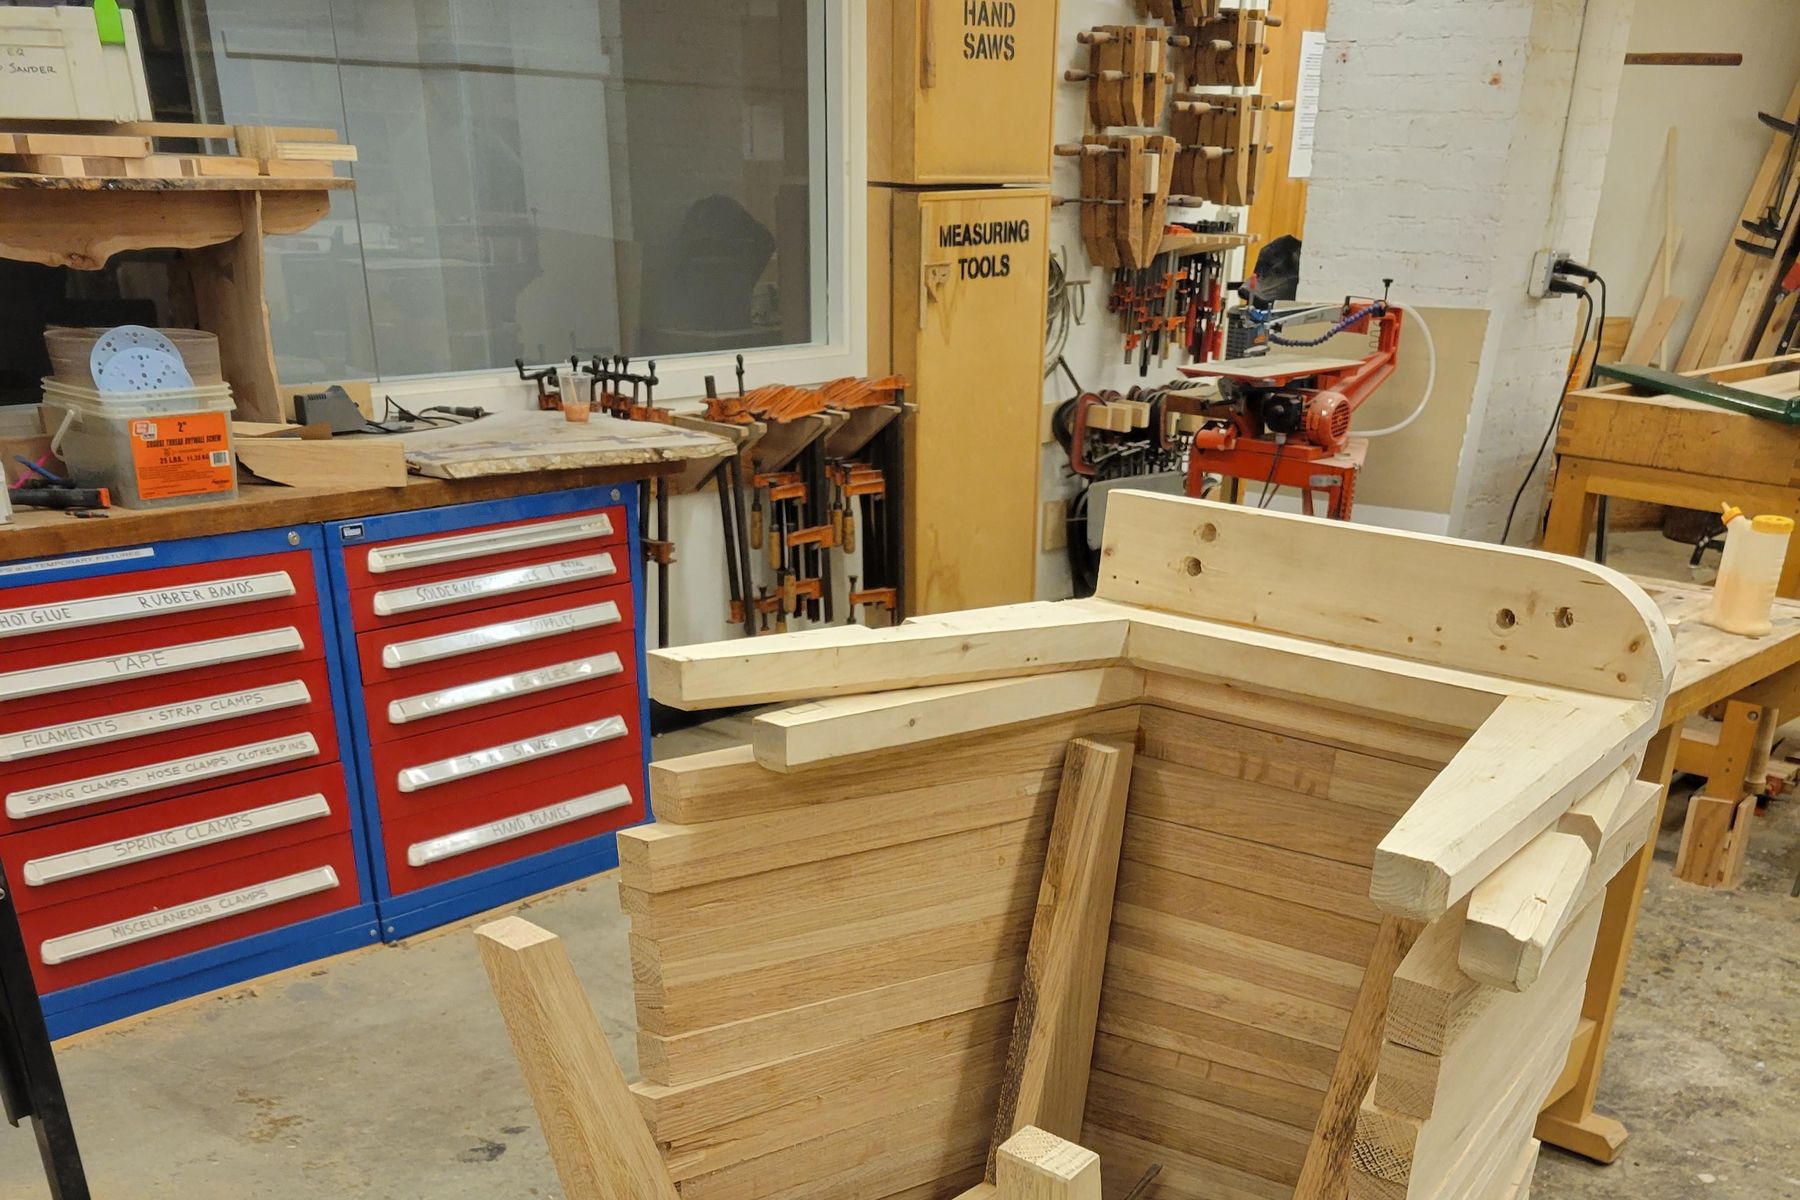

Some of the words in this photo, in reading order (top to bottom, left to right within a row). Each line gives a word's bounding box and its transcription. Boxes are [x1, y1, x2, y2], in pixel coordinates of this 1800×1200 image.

[964, 0, 1015, 28] HAND
[963, 33, 1015, 61] SAWS
[9, 63, 57, 74] SANDER
[939, 220, 1030, 248] MEASURING
[958, 254, 1010, 281] TOOLS
[34, 557, 93, 570] TEMPORARY
[0, 612, 28, 628] HOT
[30, 608, 72, 624] GLUE
[137, 589, 201, 609] RUBBER
[208, 580, 255, 600] BANDS
[416, 580, 483, 602] SOLDERING
[108, 651, 169, 674] TAPE
[22, 719, 118, 749] FILAMENTS
[159, 703, 203, 722] STRAP
[210, 692, 264, 712] CLAMPS
[26, 787, 75, 805] SPRING
[81, 777, 129, 795] CLAMPS
[147, 765, 181, 781] HOSE
[185, 757, 229, 773] CLAMPS
[112, 830, 178, 857] SPRING
[185, 815, 253, 841] CLAMPS
[491, 817, 526, 838] HAND
[530, 806, 572, 826] PLANES
[111, 903, 212, 938] MISCELLANEOUS
[218, 889, 269, 909] CLAMPS
